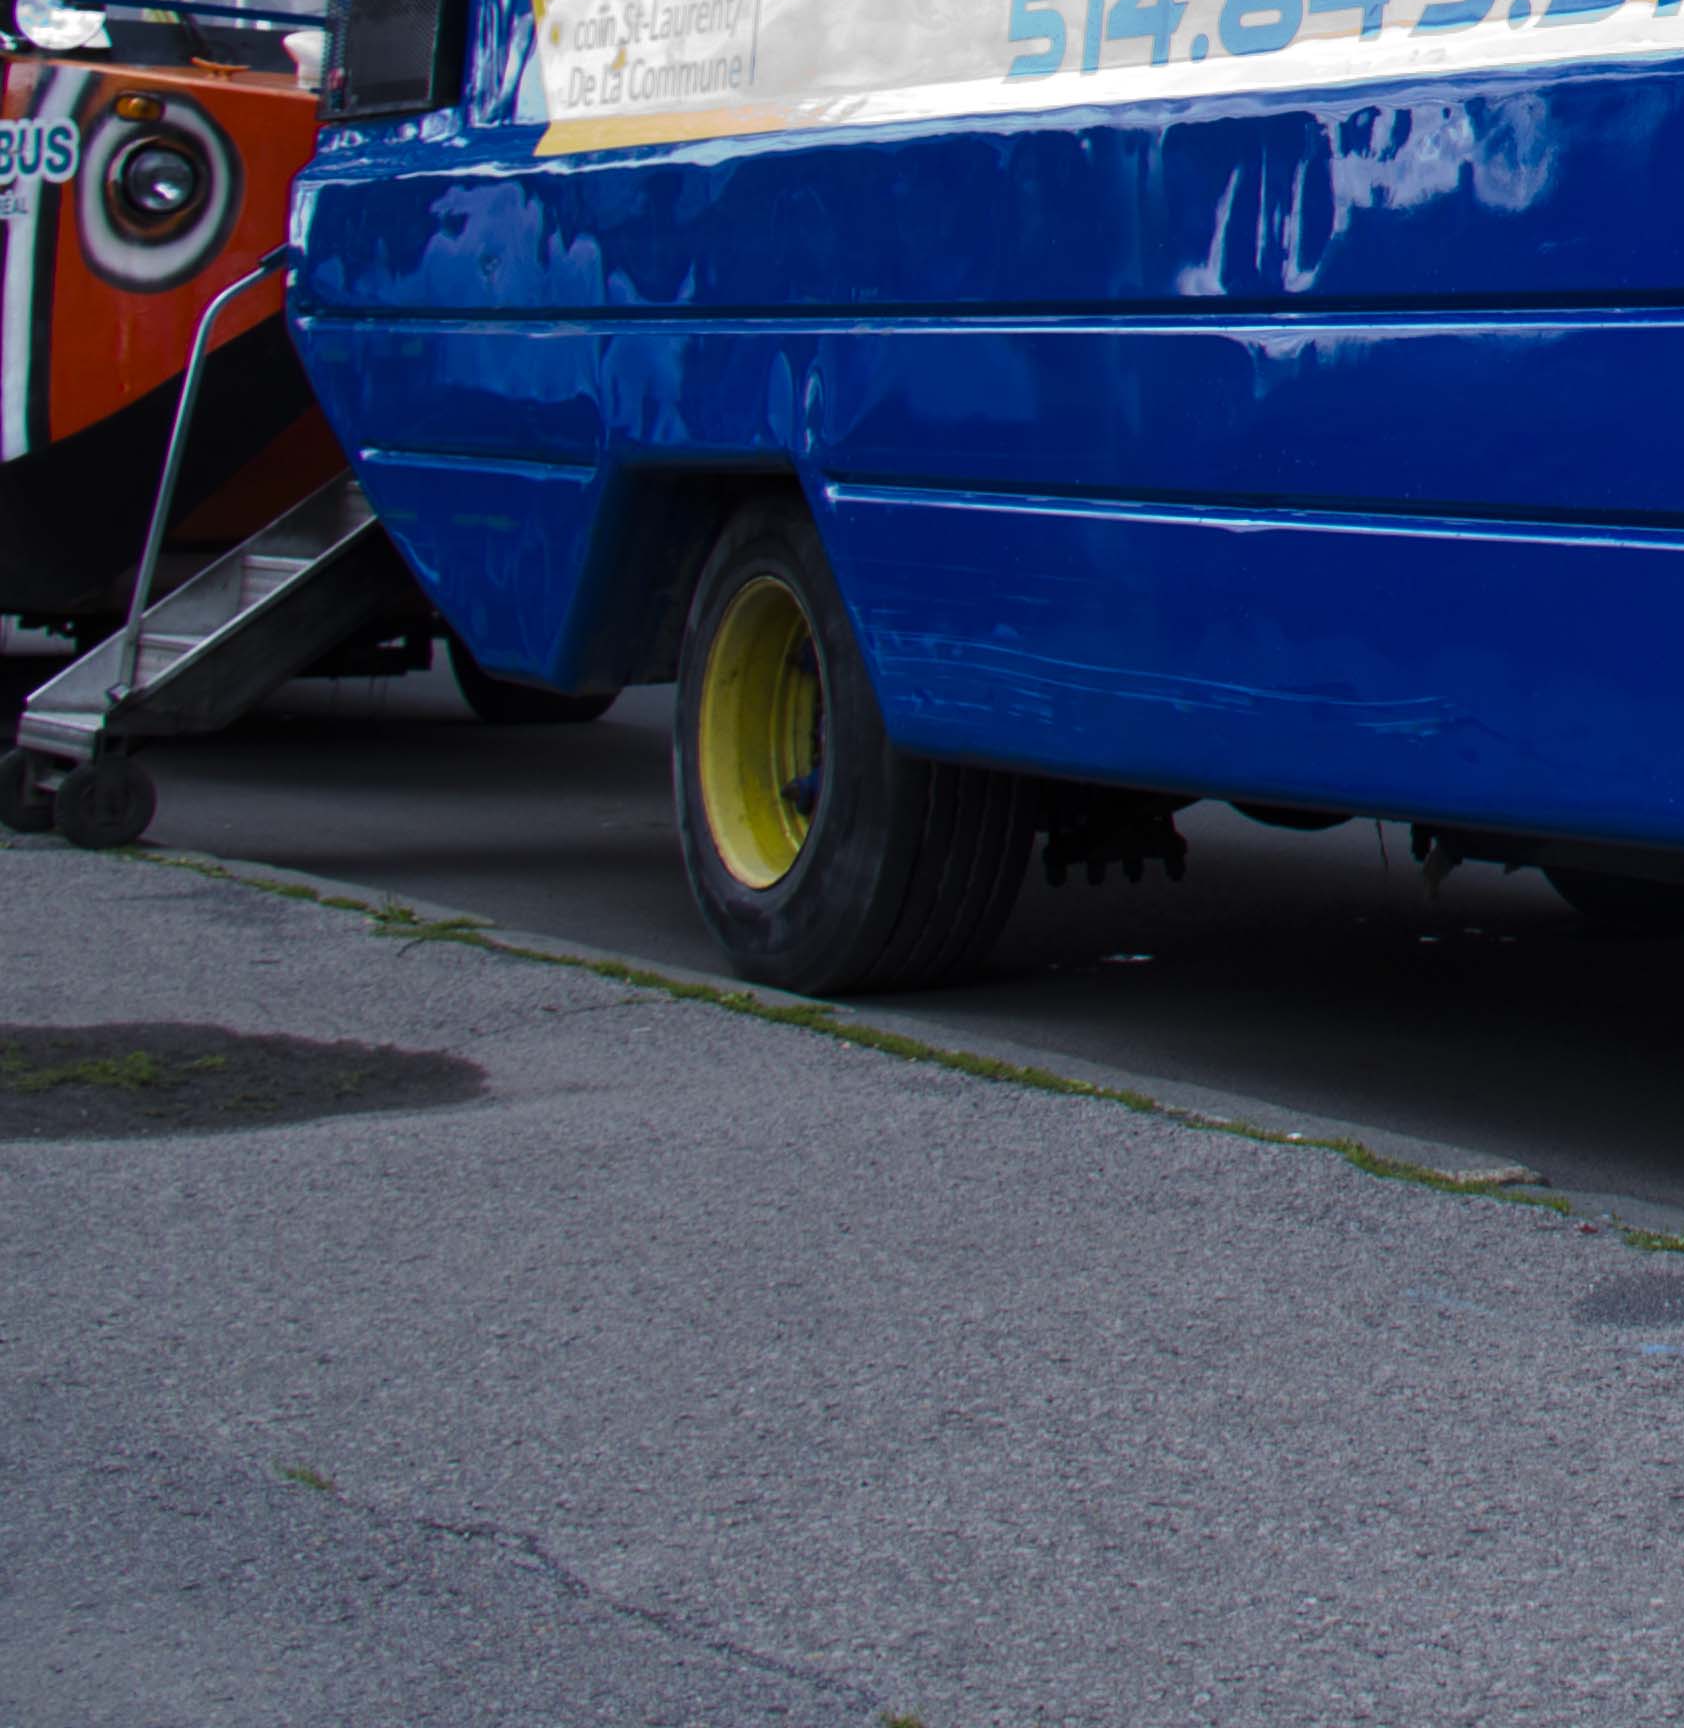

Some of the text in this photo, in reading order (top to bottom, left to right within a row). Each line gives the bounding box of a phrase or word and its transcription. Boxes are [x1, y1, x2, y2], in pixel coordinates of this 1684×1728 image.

[568, 54, 743, 109] De La Commune
